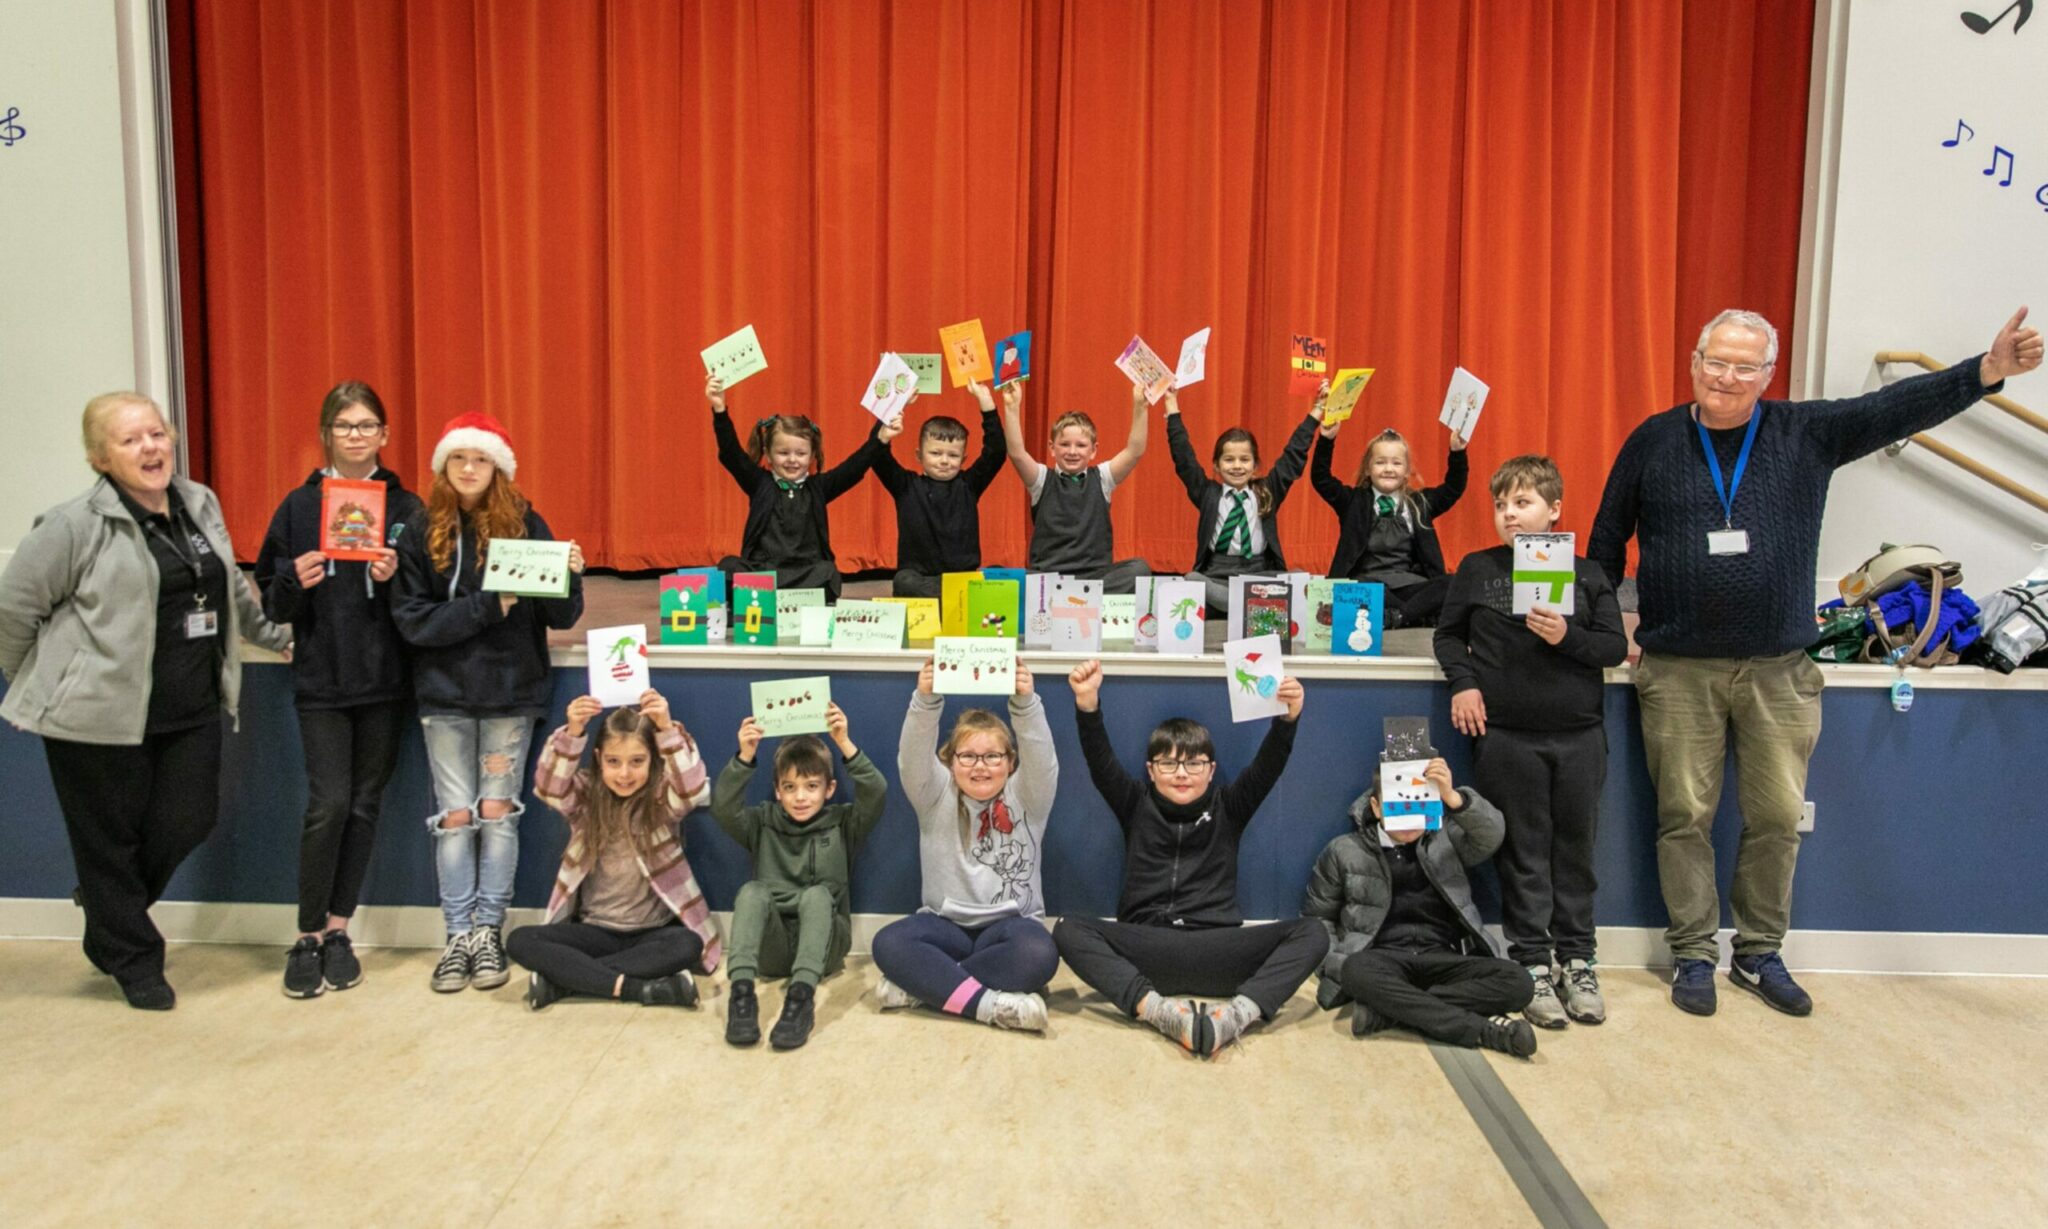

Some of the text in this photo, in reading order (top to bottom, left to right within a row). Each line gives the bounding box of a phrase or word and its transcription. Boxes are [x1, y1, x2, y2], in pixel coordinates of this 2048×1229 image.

[499, 545, 562, 559] Merry Christmas
[841, 628, 897, 642] Merry Christmas
[940, 643, 1008, 657] Merry Christmas
[758, 712, 822, 728] Merry Christmas
